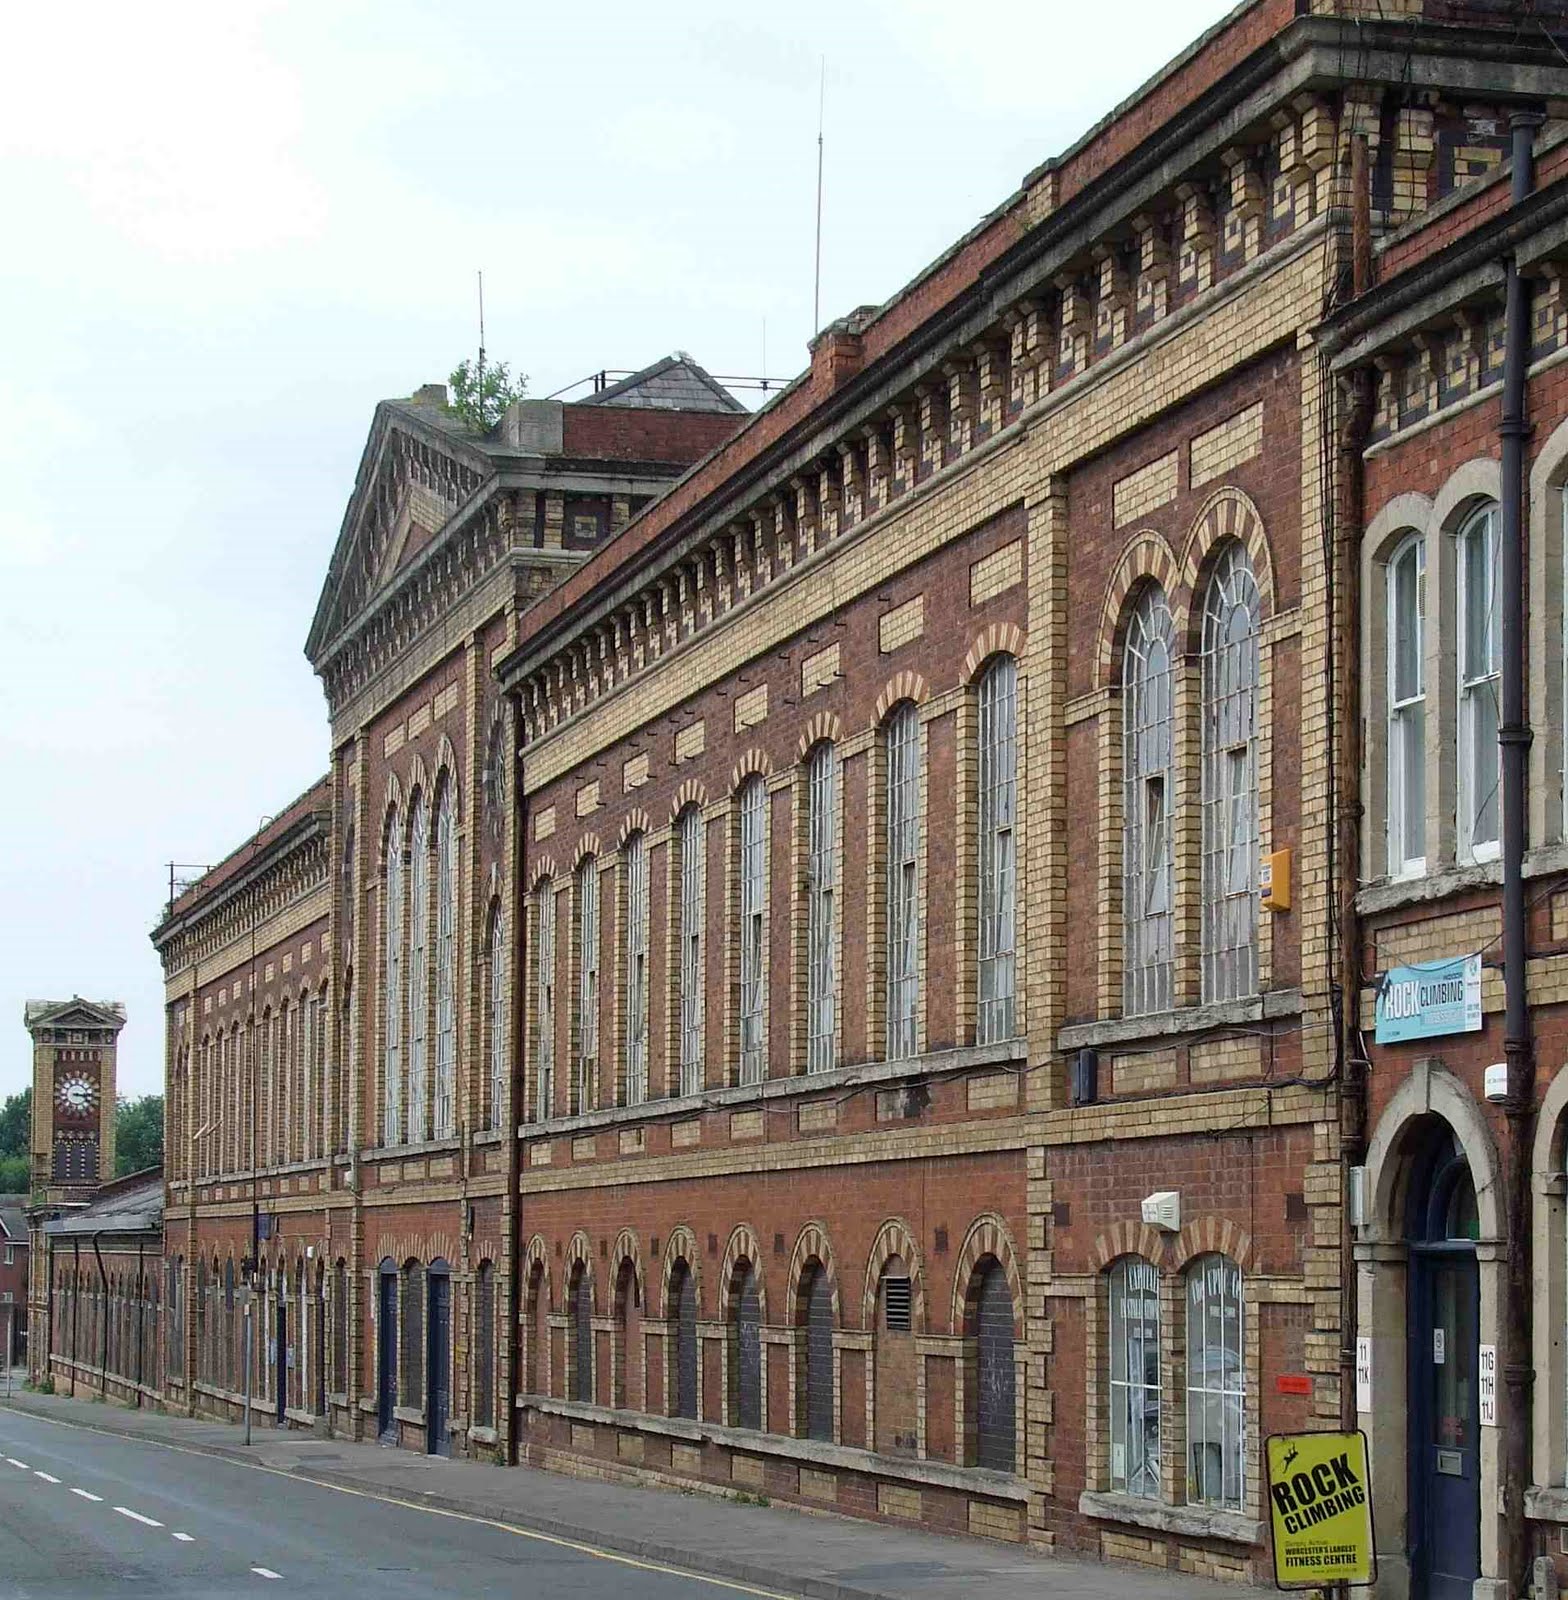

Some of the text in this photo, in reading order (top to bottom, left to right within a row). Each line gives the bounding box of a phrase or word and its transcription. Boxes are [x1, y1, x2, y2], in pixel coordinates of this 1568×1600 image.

[1384, 980, 1464, 1020] ROCK CLIMBING
[1359, 1344, 1367, 1361] 11
[1481, 1351, 1495, 1371] 11G
[1358, 1366, 1370, 1384] 11K
[1481, 1376, 1494, 1396] 11H
[1481, 1402, 1494, 1420] 11J
[1271, 1452, 1360, 1516] ROCK
[1283, 1485, 1366, 1535] CLIMBING
[1329, 1544, 1357, 1554] LARGEST
[1285, 1553, 1357, 1568] FITNESS CENTRE
